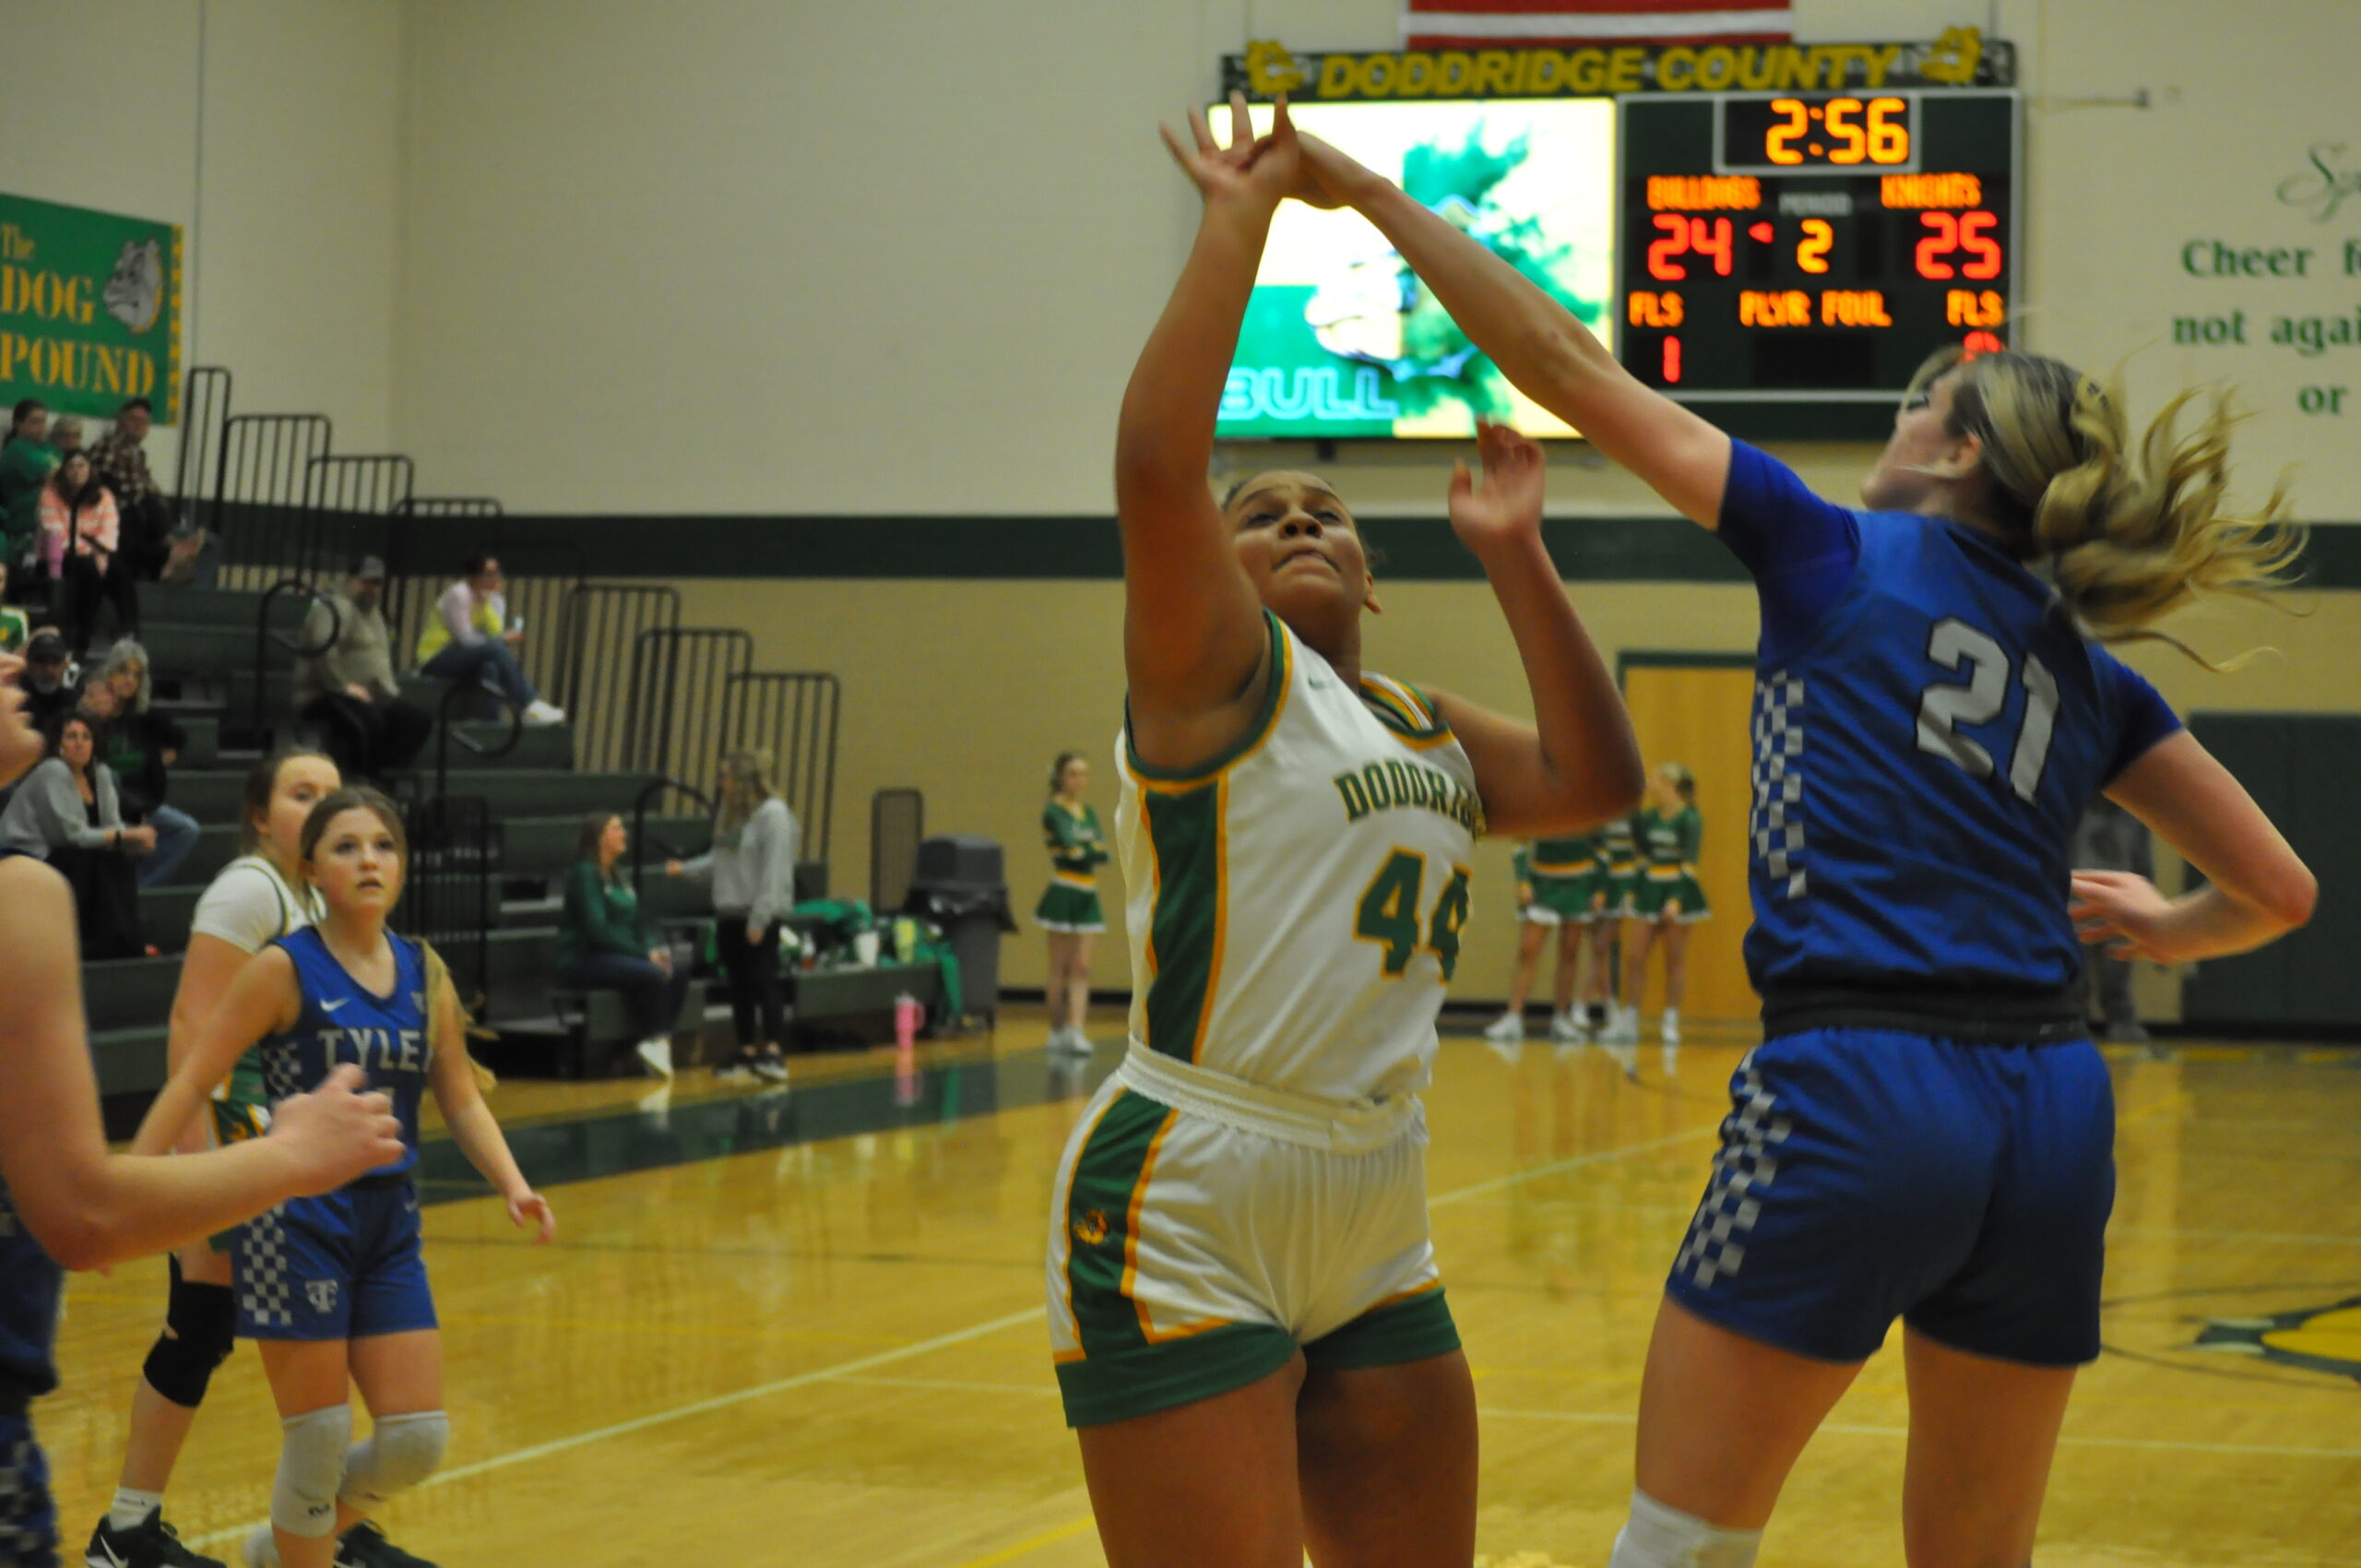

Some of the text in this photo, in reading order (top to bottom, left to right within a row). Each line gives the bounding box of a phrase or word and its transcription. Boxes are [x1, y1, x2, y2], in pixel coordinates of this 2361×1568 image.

[1318, 43, 1900, 97] DODDRIDGE COUNTY
[1765, 97, 1909, 165] 2:56
[1648, 213, 1733, 280] 24
[1797, 219, 1833, 274] 2
[1916, 211, 2001, 280] 25
[2182, 238, 2313, 277] Cheer
[2, 264, 95, 325] DOG
[1629, 291, 1684, 327] FLS
[1821, 290, 1893, 327] FOUL
[1947, 289, 2003, 327] FLS
[2174, 307, 2248, 345] not
[0, 332, 155, 398] POUND
[1663, 335, 1681, 384] 1
[1216, 366, 1400, 420] BULL
[2297, 384, 2348, 416] or
[1916, 616, 2060, 807] 21
[1352, 846, 1472, 985] 44
